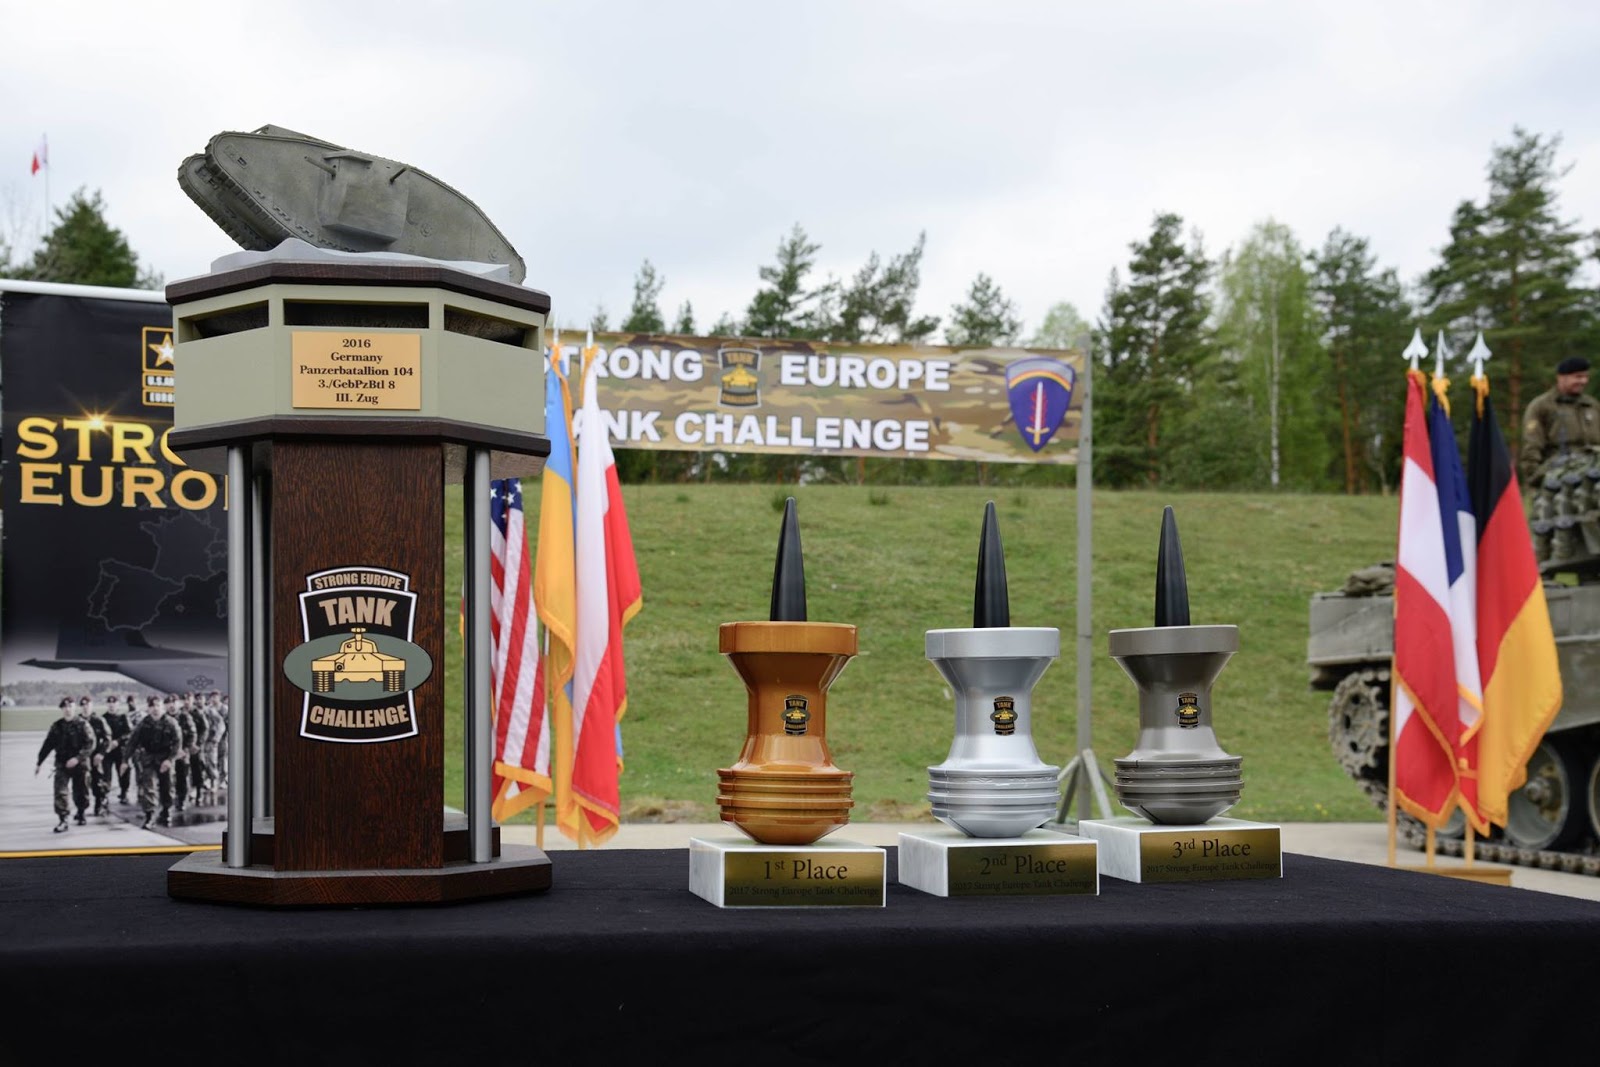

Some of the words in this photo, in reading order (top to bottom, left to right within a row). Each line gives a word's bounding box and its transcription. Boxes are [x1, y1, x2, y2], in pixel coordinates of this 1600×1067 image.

[342, 338, 371, 348] 2016
[330, 351, 383, 364] Germany
[544, 344, 704, 382] TRONG
[780, 354, 950, 391] EUROPE
[299, 365, 389, 376] Panzerbatallion
[393, 367, 413, 376] 104
[318, 379, 385, 389] 3./GebPzBtl
[388, 380, 395, 389] 8
[335, 393, 353, 402] III.
[356, 393, 379, 405] Zug
[571, 408, 661, 442] NK
[674, 412, 929, 451] CHALLENGE
[16, 417, 187, 466] STR
[20, 462, 228, 511] EURO
[314, 573, 359, 590] STRONG
[360, 573, 402, 590] EUROPE
[319, 596, 398, 627] TANK
[309, 704, 410, 728] CHALLENGE
[1172, 838, 1195, 858] 3rd
[1202, 838, 1250, 857] Place
[764, 860, 785, 880] 1st
[792, 859, 848, 880] Place
[980, 854, 1007, 875] 2nd
[1014, 854, 1067, 874] Place
[1166, 864, 1191, 874] Strong
[1192, 863, 1219, 873] Europe
[1221, 862, 1239, 871] Tank
[1241, 861, 1279, 871] Challenge
[729, 886, 749, 896] 2017
[751, 886, 780, 898] Strong
[781, 886, 812, 897] Europe
[815, 885, 835, 896] Tank
[837, 885, 880, 898] Challenge
